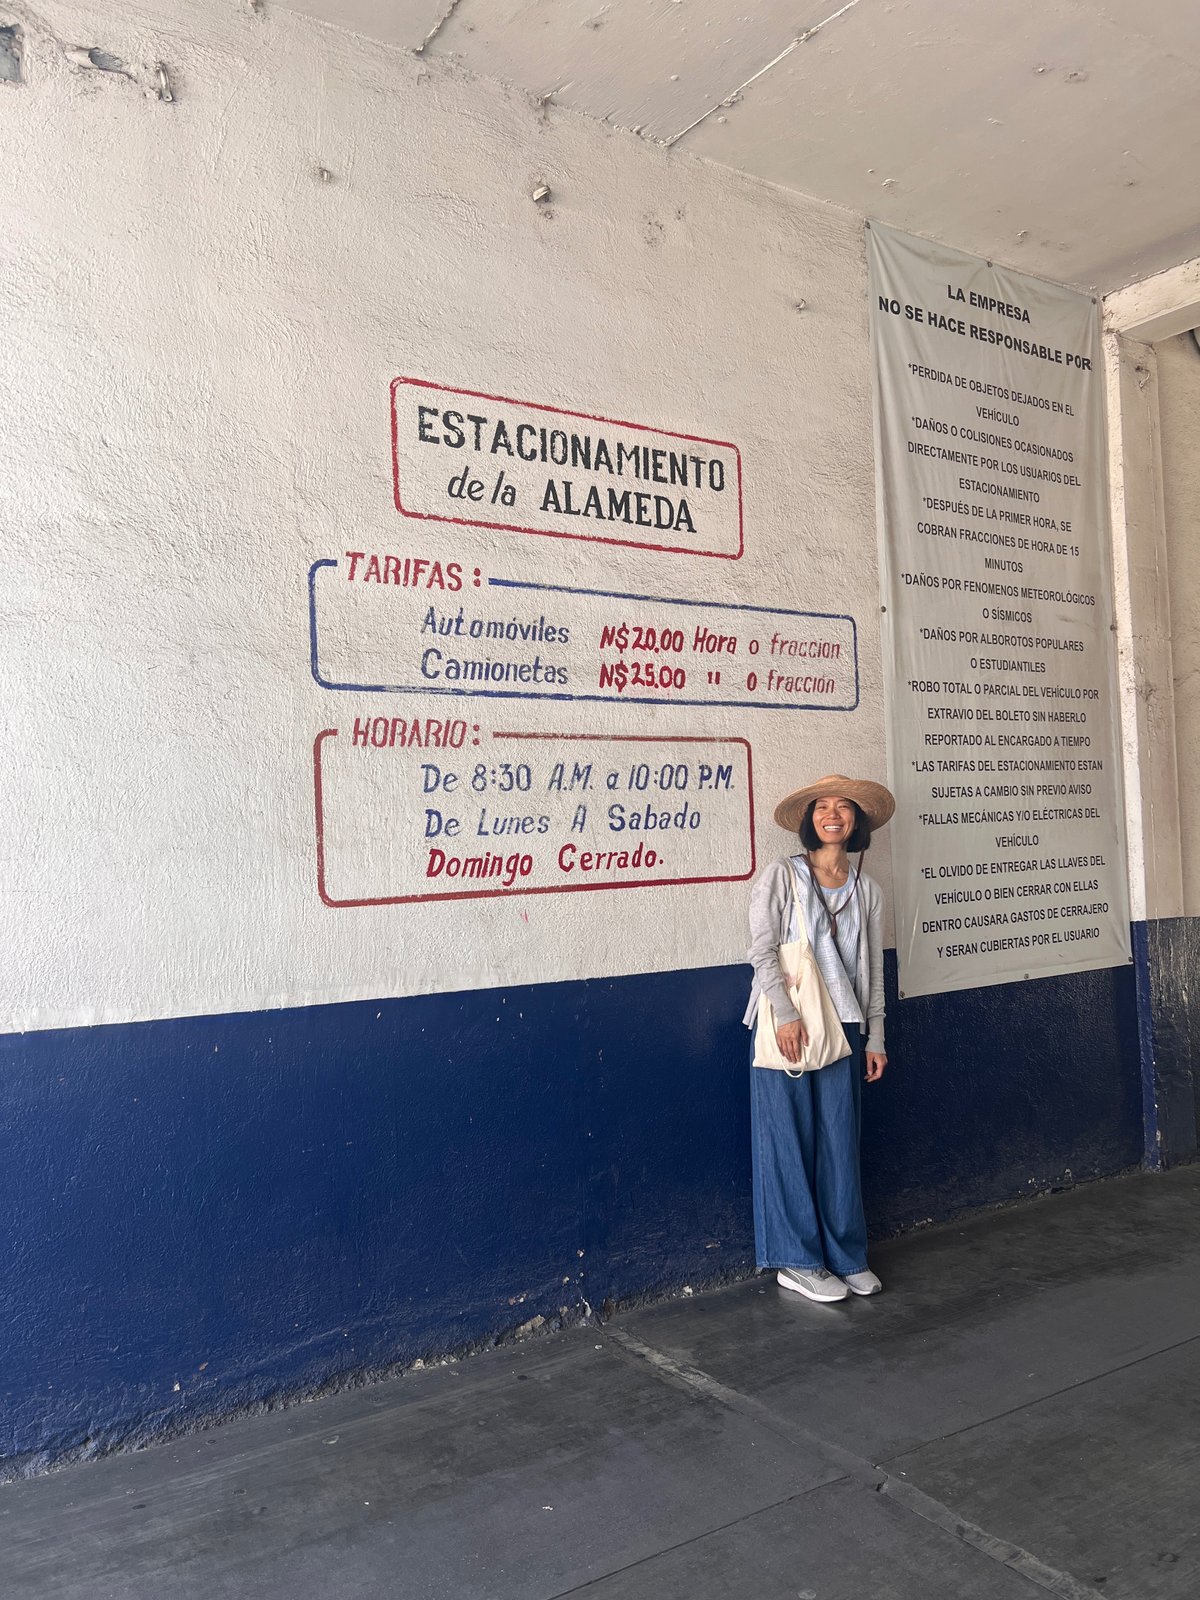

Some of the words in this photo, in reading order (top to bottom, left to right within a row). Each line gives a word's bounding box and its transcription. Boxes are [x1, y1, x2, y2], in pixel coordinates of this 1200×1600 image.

[948, 284, 965, 302] LA
[970, 292, 1030, 323] EMPRESA
[879, 296, 901, 314] NO
[905, 305, 923, 322] SE
[928, 311, 965, 335] HACE
[970, 325, 1062, 363] RESPONSABLE
[955, 375, 967, 388] DE
[969, 380, 1009, 399] OBJETOS
[1011, 391, 1050, 410] DEJADOS
[1052, 402, 1063, 412] EN
[1066, 405, 1074, 416] EL
[976, 406, 1019, 426] VEHÍCULO
[418, 405, 725, 492] ESTACIONAMIENTO
[951, 425, 957, 436] O
[960, 427, 1012, 449] COLISIONES
[1014, 440, 1073, 462] OCASIONADOS
[908, 441, 978, 466] DIRECTAMENTE
[981, 457, 999, 471] POR
[1001, 461, 1018, 474] LOS
[1020, 466, 1062, 484] USUARIOS
[1064, 475, 1081, 486] DEL
[447, 465, 484, 501] de
[491, 470, 516, 506] la
[539, 479, 696, 533] ALAMEDA
[959, 478, 1039, 502] ESTACIONAMIENTO
[972, 505, 984, 517] DE
[986, 509, 997, 520] LA
[1000, 511, 1031, 526] PRIMER
[1033, 517, 1059, 531] HORA,
[1061, 521, 1072, 532] SE
[917, 522, 957, 538] COBRAN
[960, 529, 1016, 547] FRACCIONES
[1018, 537, 1029, 548] DE
[1031, 540, 1054, 553] HORA
[1056, 544, 1068, 555] DE
[1070, 546, 1079, 556] 15
[985, 558, 1023, 572] MINUTOS
[942, 577, 962, 590] POR
[964, 581, 1018, 597] FENOMENOS
[1021, 587, 1095, 606] METEOROLÓGICOS
[982, 608, 989, 619] O
[992, 607, 1032, 622] SÍSMICOS
[420, 606, 569, 643] Automóviles
[693, 626, 737, 654] Hora
[959, 631, 978, 643] POR
[981, 634, 1033, 648] ALBOROTOS
[1036, 638, 1083, 651] POPULARES
[421, 648, 568, 684] Camionetas
[970, 658, 977, 669] O
[980, 658, 1046, 672] ESTUDIANTILES
[943, 682, 972, 694] TOTAL
[974, 684, 981, 694] O
[984, 684, 1021, 696] PARCIAL
[1023, 686, 1039, 697] DEL
[1041, 684, 1081, 699] VEHÍCULO
[1083, 689, 1099, 700] POR
[928, 708, 974, 720] EXTRAVIO
[976, 709, 994, 721] DEL
[996, 710, 1030, 721] BOLETO
[1033, 711, 1046, 721] SIN
[1048, 711, 1086, 722] HABERLO
[925, 734, 982, 746] REPORTADO
[984, 735, 996, 746] AL
[998, 735, 1052, 746] ENCARGADO
[1054, 737, 1060, 746] A
[1061, 736, 1090, 746] TIEMPO
[421, 764, 458, 793] De
[471, 764, 532, 792] 8:30
[548, 762, 593, 791] A.M.
[606, 772, 620, 790] a
[628, 764, 688, 791] 10:00
[938, 761, 975, 772] TARIFAS
[978, 761, 995, 771] DEL
[998, 760, 1076, 771] ESTACIONAMIENTO
[1078, 760, 1103, 770] ESTAN
[932, 786, 973, 798] SUJETAS
[975, 786, 982, 797] A
[984, 785, 1018, 797] CAMBIO
[1021, 785, 1034, 796] SIN
[1036, 785, 1066, 796] PREVIO
[1068, 784, 1091, 795] AVISO
[425, 809, 461, 837] De
[476, 809, 550, 836] Lunes
[571, 804, 587, 833] A
[608, 802, 700, 832] Sabado
[961, 808, 1014, 824] MECÁNICAS
[1016, 810, 1031, 822] Y/O
[1033, 807, 1083, 821] ELÉCTRICAS
[1085, 808, 1100, 818] DEL
[995, 834, 1039, 848] VEHÍCULO
[426, 848, 533, 886] Domingo
[558, 842, 664, 872] Cerrado.
[939, 864, 973, 878] OLVIDO
[976, 864, 988, 875] DE
[991, 860, 1037, 874] ENTREGAR
[1040, 858, 1056, 870] LAS
[1058, 856, 1088, 868] LLAVES
[1090, 855, 1105, 866] DEL
[935, 889, 982, 905] VEHÍCULO
[984, 888, 991, 900] O
[993, 886, 1015, 898] BIEN
[1017, 882, 1052, 897] CERRAR
[1054, 881, 1071, 893] CON
[1073, 880, 1098, 891] ELLAS
[923, 918, 962, 933] DENTRO
[964, 913, 1008, 929] CAUSARA
[1011, 909, 1046, 923] GASTOS
[1048, 908, 1059, 919] DE
[1061, 902, 1109, 917] CERRAJERO
[937, 947, 944, 958] Y
[946, 943, 978, 958] SERAN
[980, 936, 1030, 953] CUBIERTAS
[1032, 934, 1050, 946] POR
[1052, 932, 1063, 943] EL
[1064, 927, 1100, 942] USUARIO
